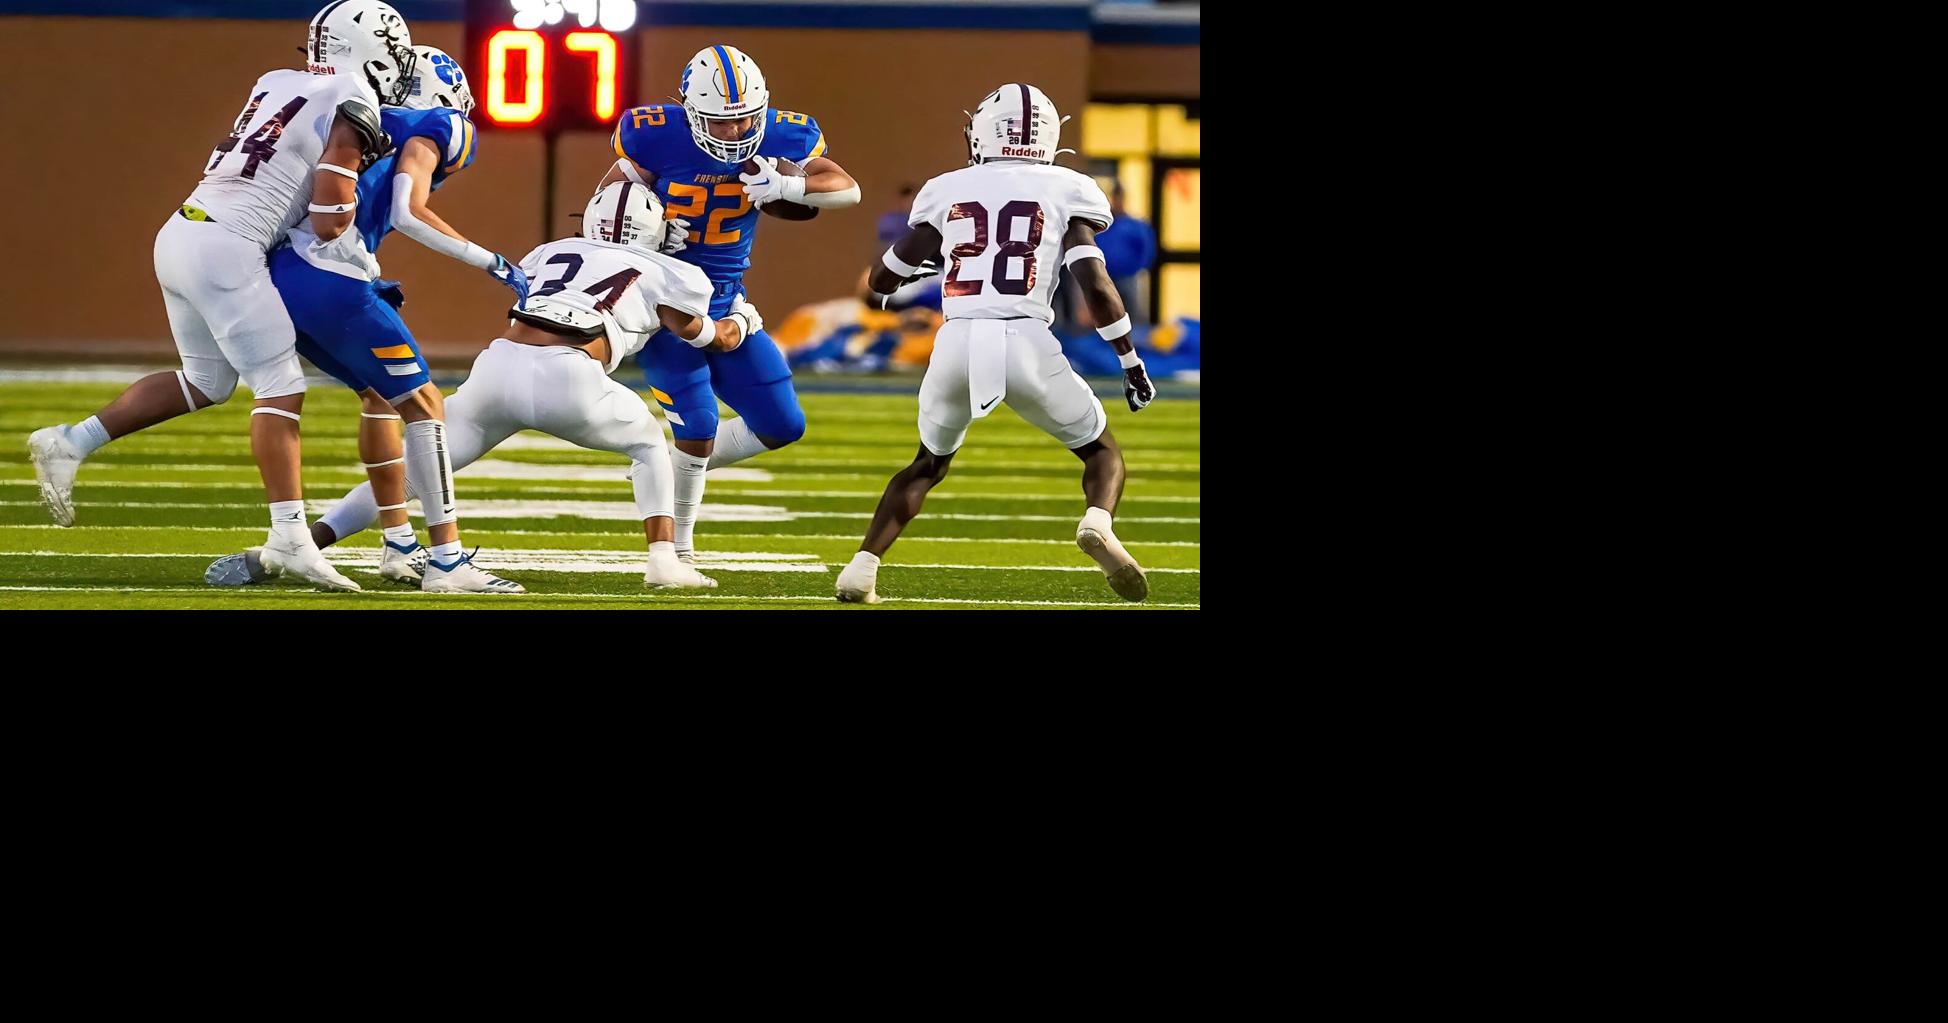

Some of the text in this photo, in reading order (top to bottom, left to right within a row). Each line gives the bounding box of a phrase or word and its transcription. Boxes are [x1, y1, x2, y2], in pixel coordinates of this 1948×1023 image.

[487, 30, 616, 122] 07
[723, 103, 746, 111] Riddell
[1002, 146, 1045, 159] Riddell
[1008, 136, 1020, 145] 28
[665, 181, 752, 245] 22
[943, 200, 1045, 298] 28
[528, 253, 642, 314] 34
